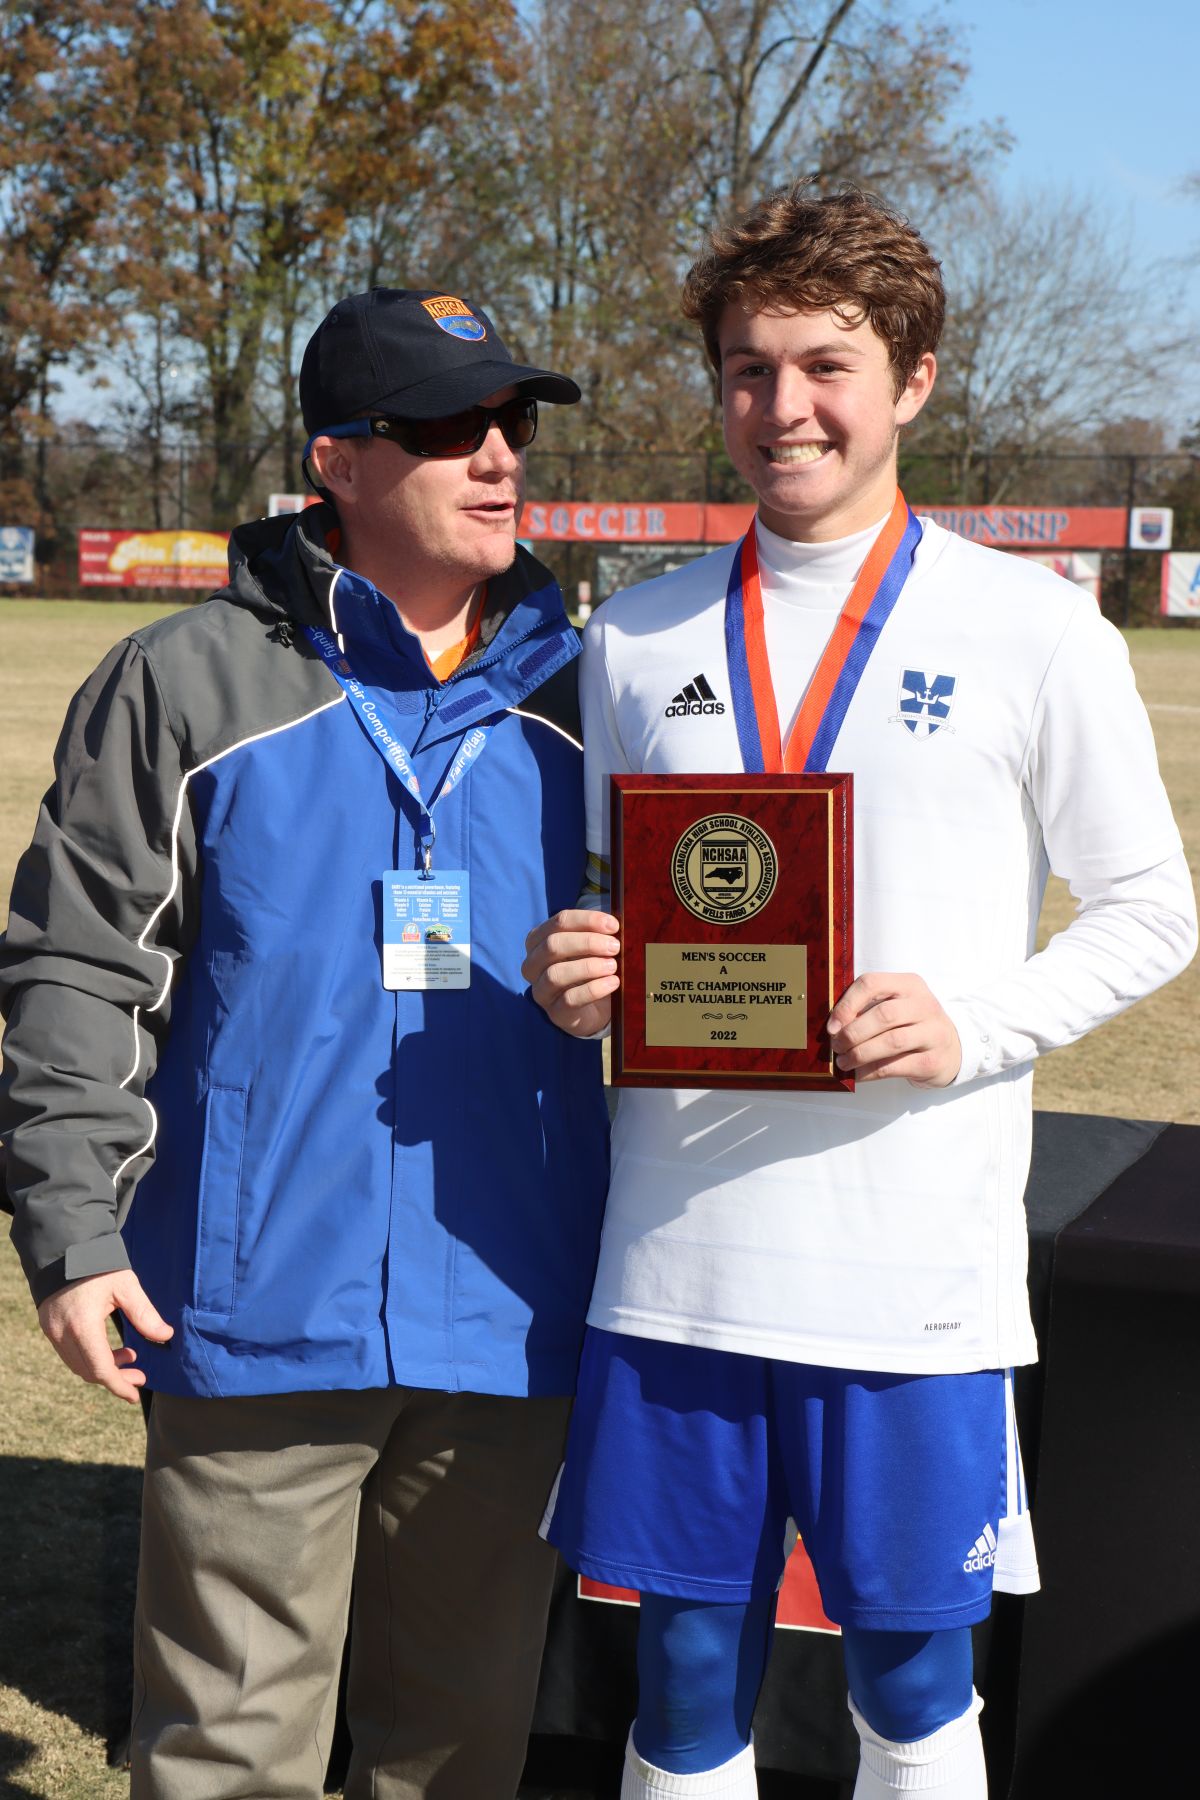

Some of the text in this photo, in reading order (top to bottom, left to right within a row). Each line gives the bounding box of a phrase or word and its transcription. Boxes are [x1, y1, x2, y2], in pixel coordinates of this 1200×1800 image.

[529, 506, 667, 536] SOCCER
[920, 509, 1069, 543] PIONSHIP
[664, 699, 726, 718] adidas
[345, 678, 410, 775] Fair Competition
[450, 729, 486, 781] Fair Play
[676, 819, 773, 902] NORTH CAROLINA HIGH SCHOOL ATHLETIC ASSOCIATION
[702, 847, 747, 862] NCHSAA
[702, 906, 747, 919] WELLS FARGO
[681, 952, 767, 962] MEN'S SOCCER
[719, 965, 728, 975] A
[660, 981, 787, 992] STATE CHAMPIONSHIP
[653, 994, 793, 1005] MOST VALUABLE PLAYER
[710, 1031, 737, 1040] 2022
[963, 1551, 995, 1573] adida
